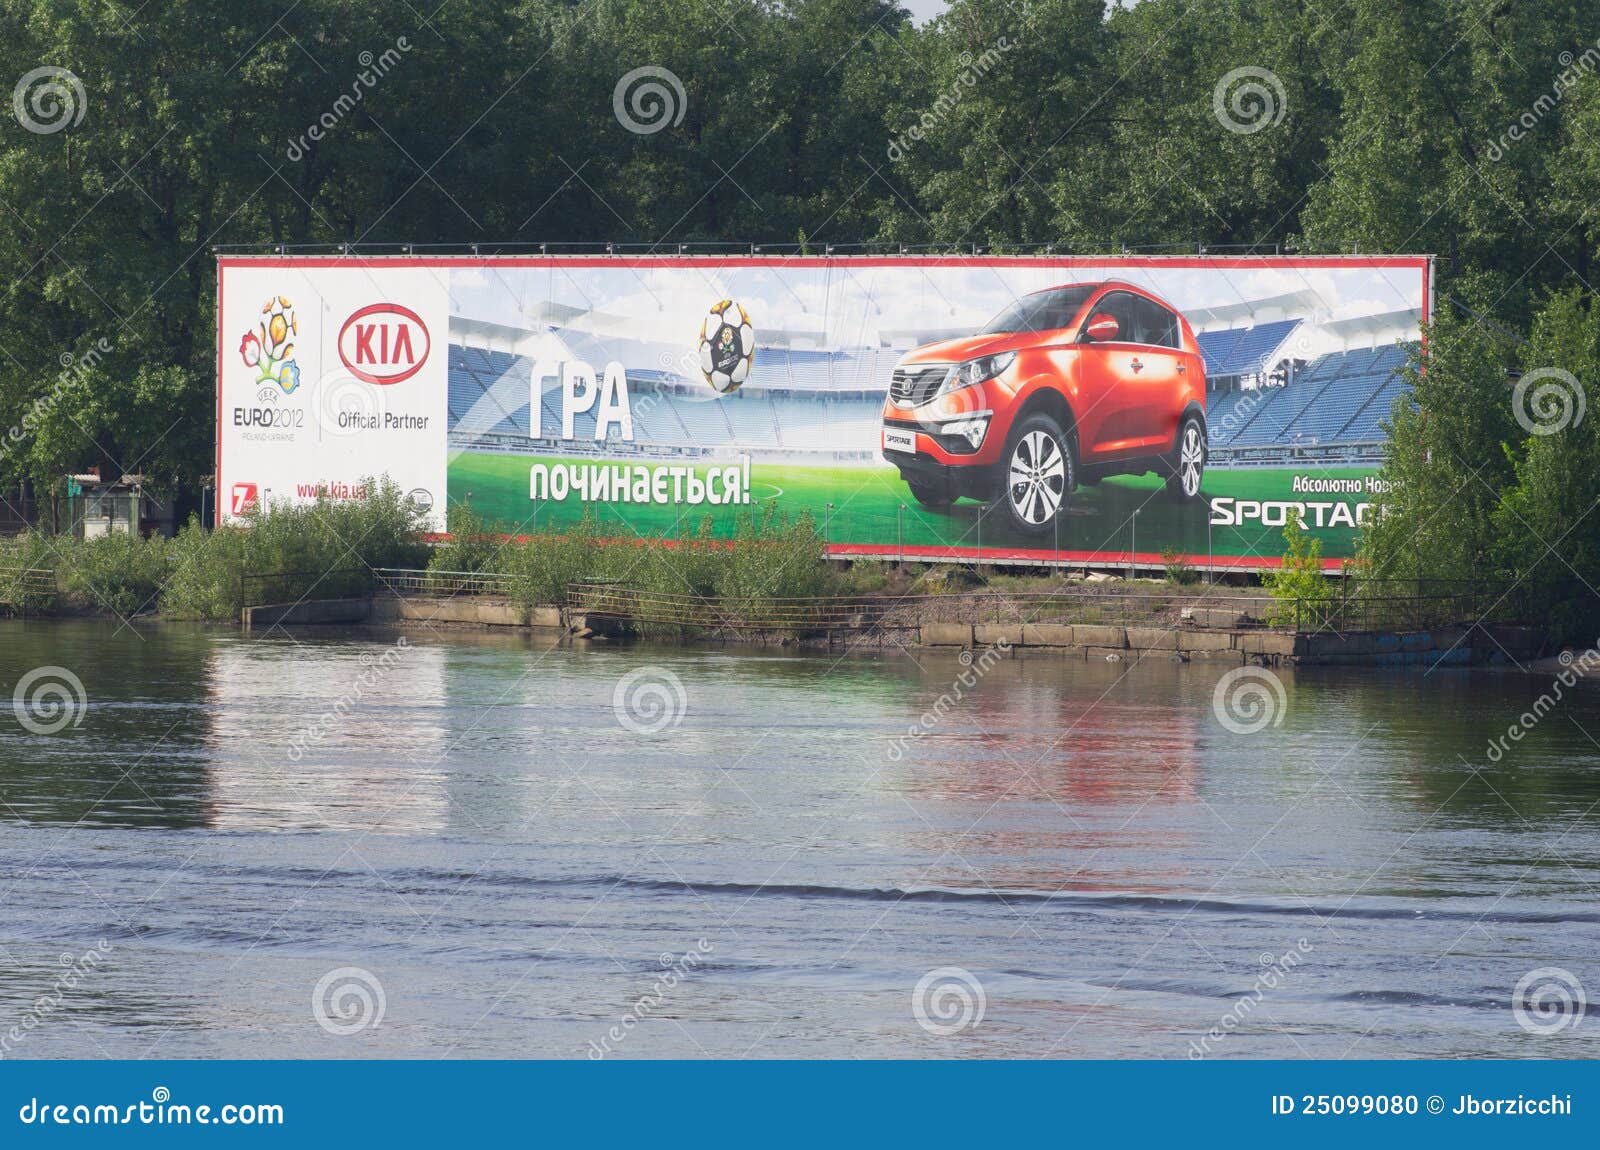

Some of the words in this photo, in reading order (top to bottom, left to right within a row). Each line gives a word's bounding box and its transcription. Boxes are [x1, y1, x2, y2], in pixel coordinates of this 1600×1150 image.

[355, 323, 415, 365] KIA
[529, 360, 635, 441] ГРА
[338, 411, 381, 429] Official
[384, 411, 429, 430] Partner
[529, 454, 751, 505] починається!
[1292, 475, 1362, 493] Абсолютно
[1364, 476, 1405, 493] Нов
[1209, 497, 1403, 530] SPORTA
